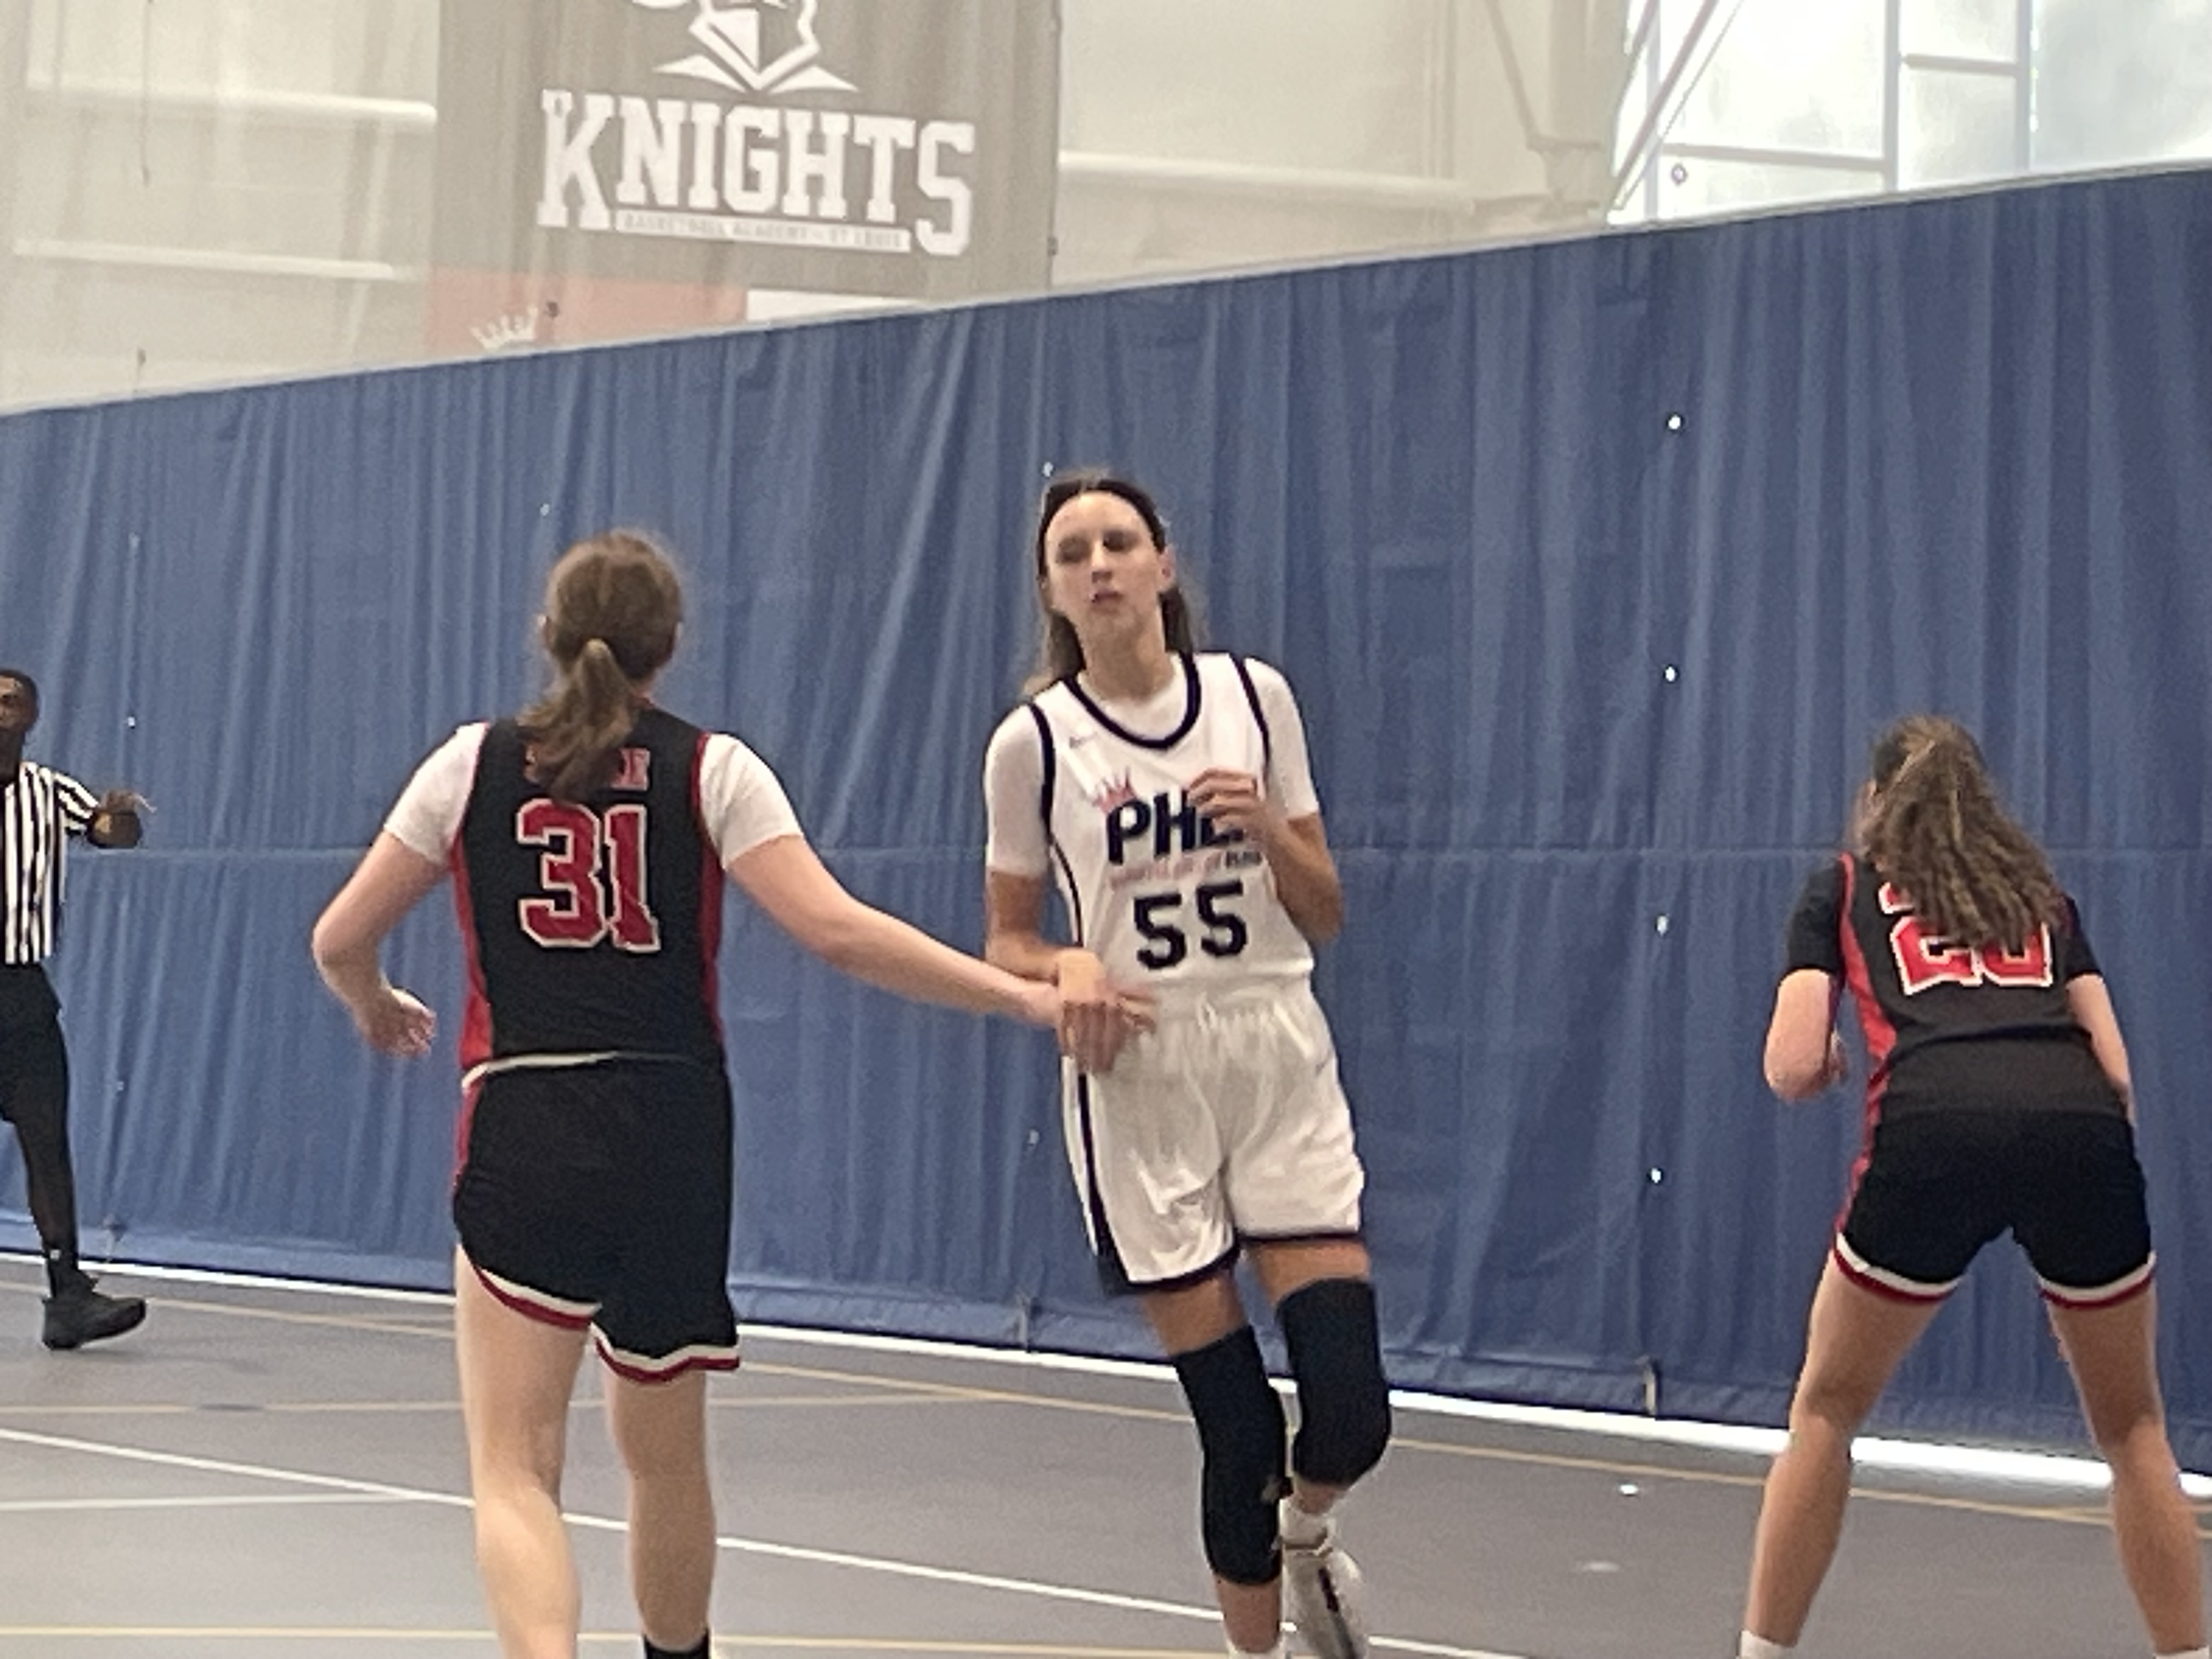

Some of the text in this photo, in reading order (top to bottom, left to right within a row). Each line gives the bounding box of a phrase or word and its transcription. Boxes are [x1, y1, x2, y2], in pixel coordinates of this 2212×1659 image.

[537, 89, 975, 256] KNIGHTS
[516, 798, 661, 953] 31
[1133, 880, 1248, 970] 55
